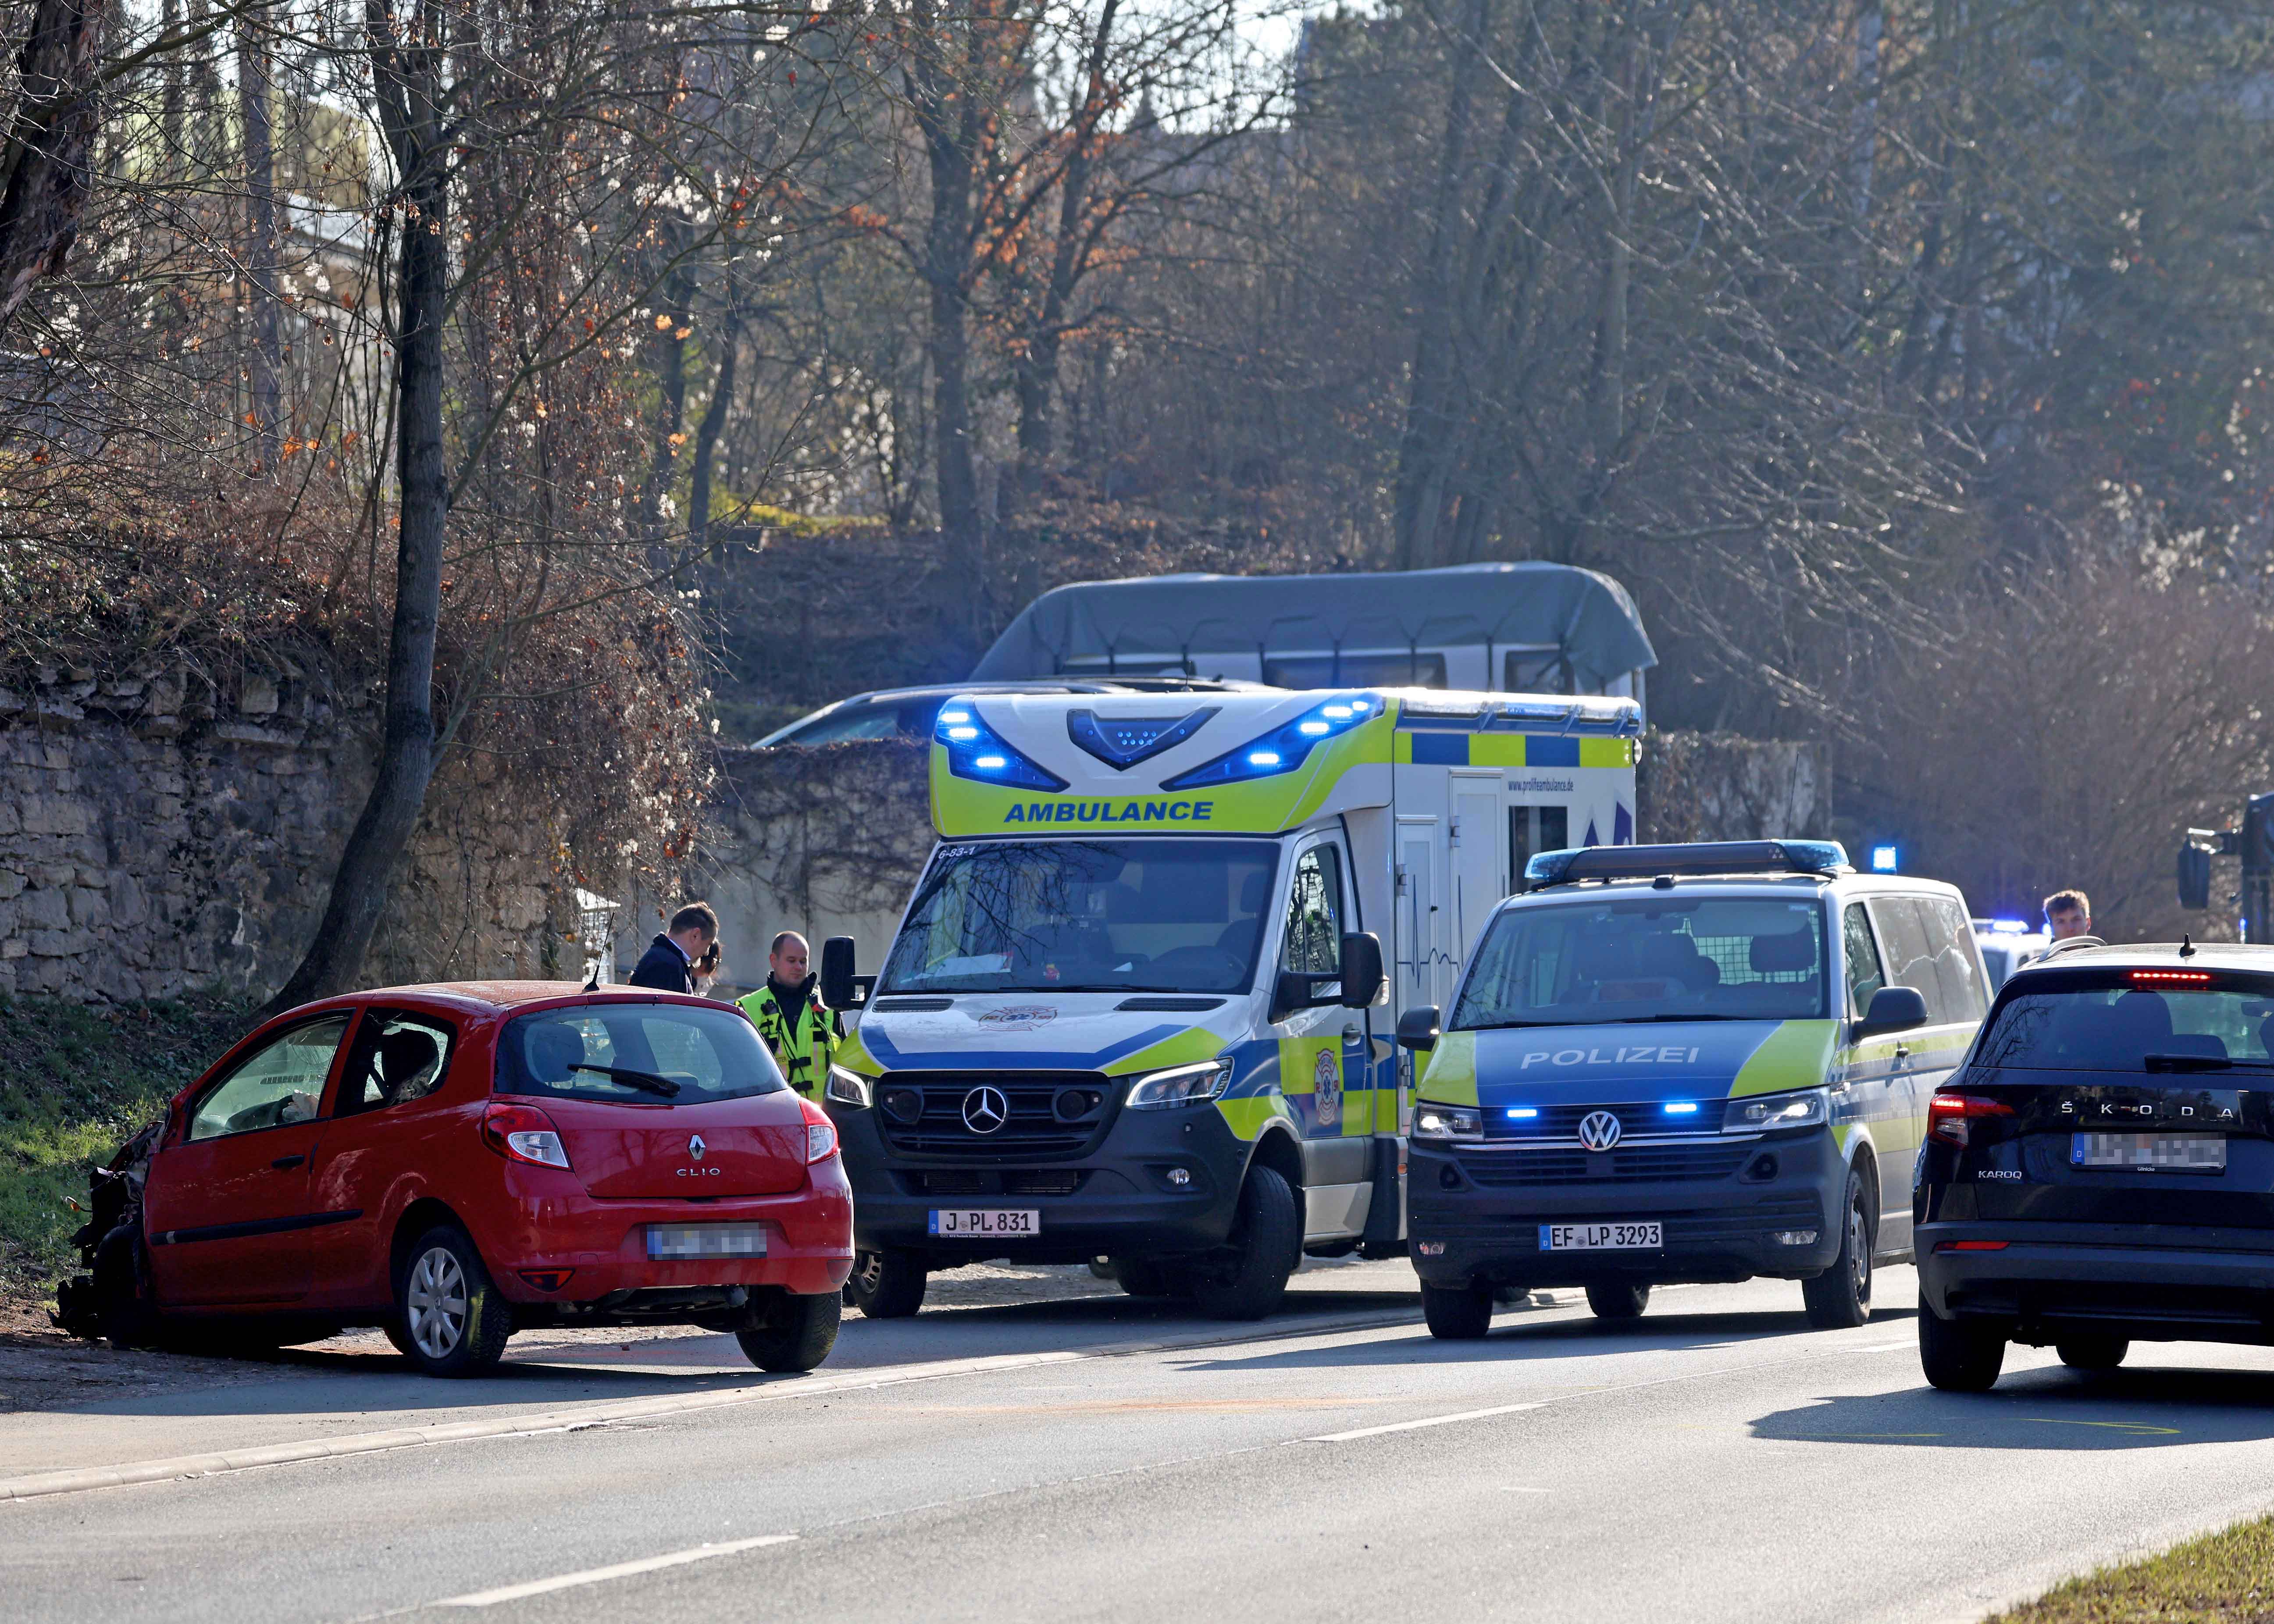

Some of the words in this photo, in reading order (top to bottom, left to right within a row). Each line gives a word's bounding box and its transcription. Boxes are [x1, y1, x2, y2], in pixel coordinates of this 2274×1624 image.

[1003, 801, 1214, 823] AMBULANCE
[938, 847, 975, 859] 6-83-1
[1520, 1047, 1700, 1069] POLIZEI
[2061, 1100, 2234, 1118] ŠKODA
[1978, 1171, 2022, 1179] KAROQ
[946, 1213, 957, 1231] J
[969, 1213, 993, 1231] PL
[997, 1213, 1031, 1231] 831
[1552, 1228, 1573, 1246] EF
[1588, 1227, 1610, 1246] LP
[1615, 1225, 1659, 1245] 3293
